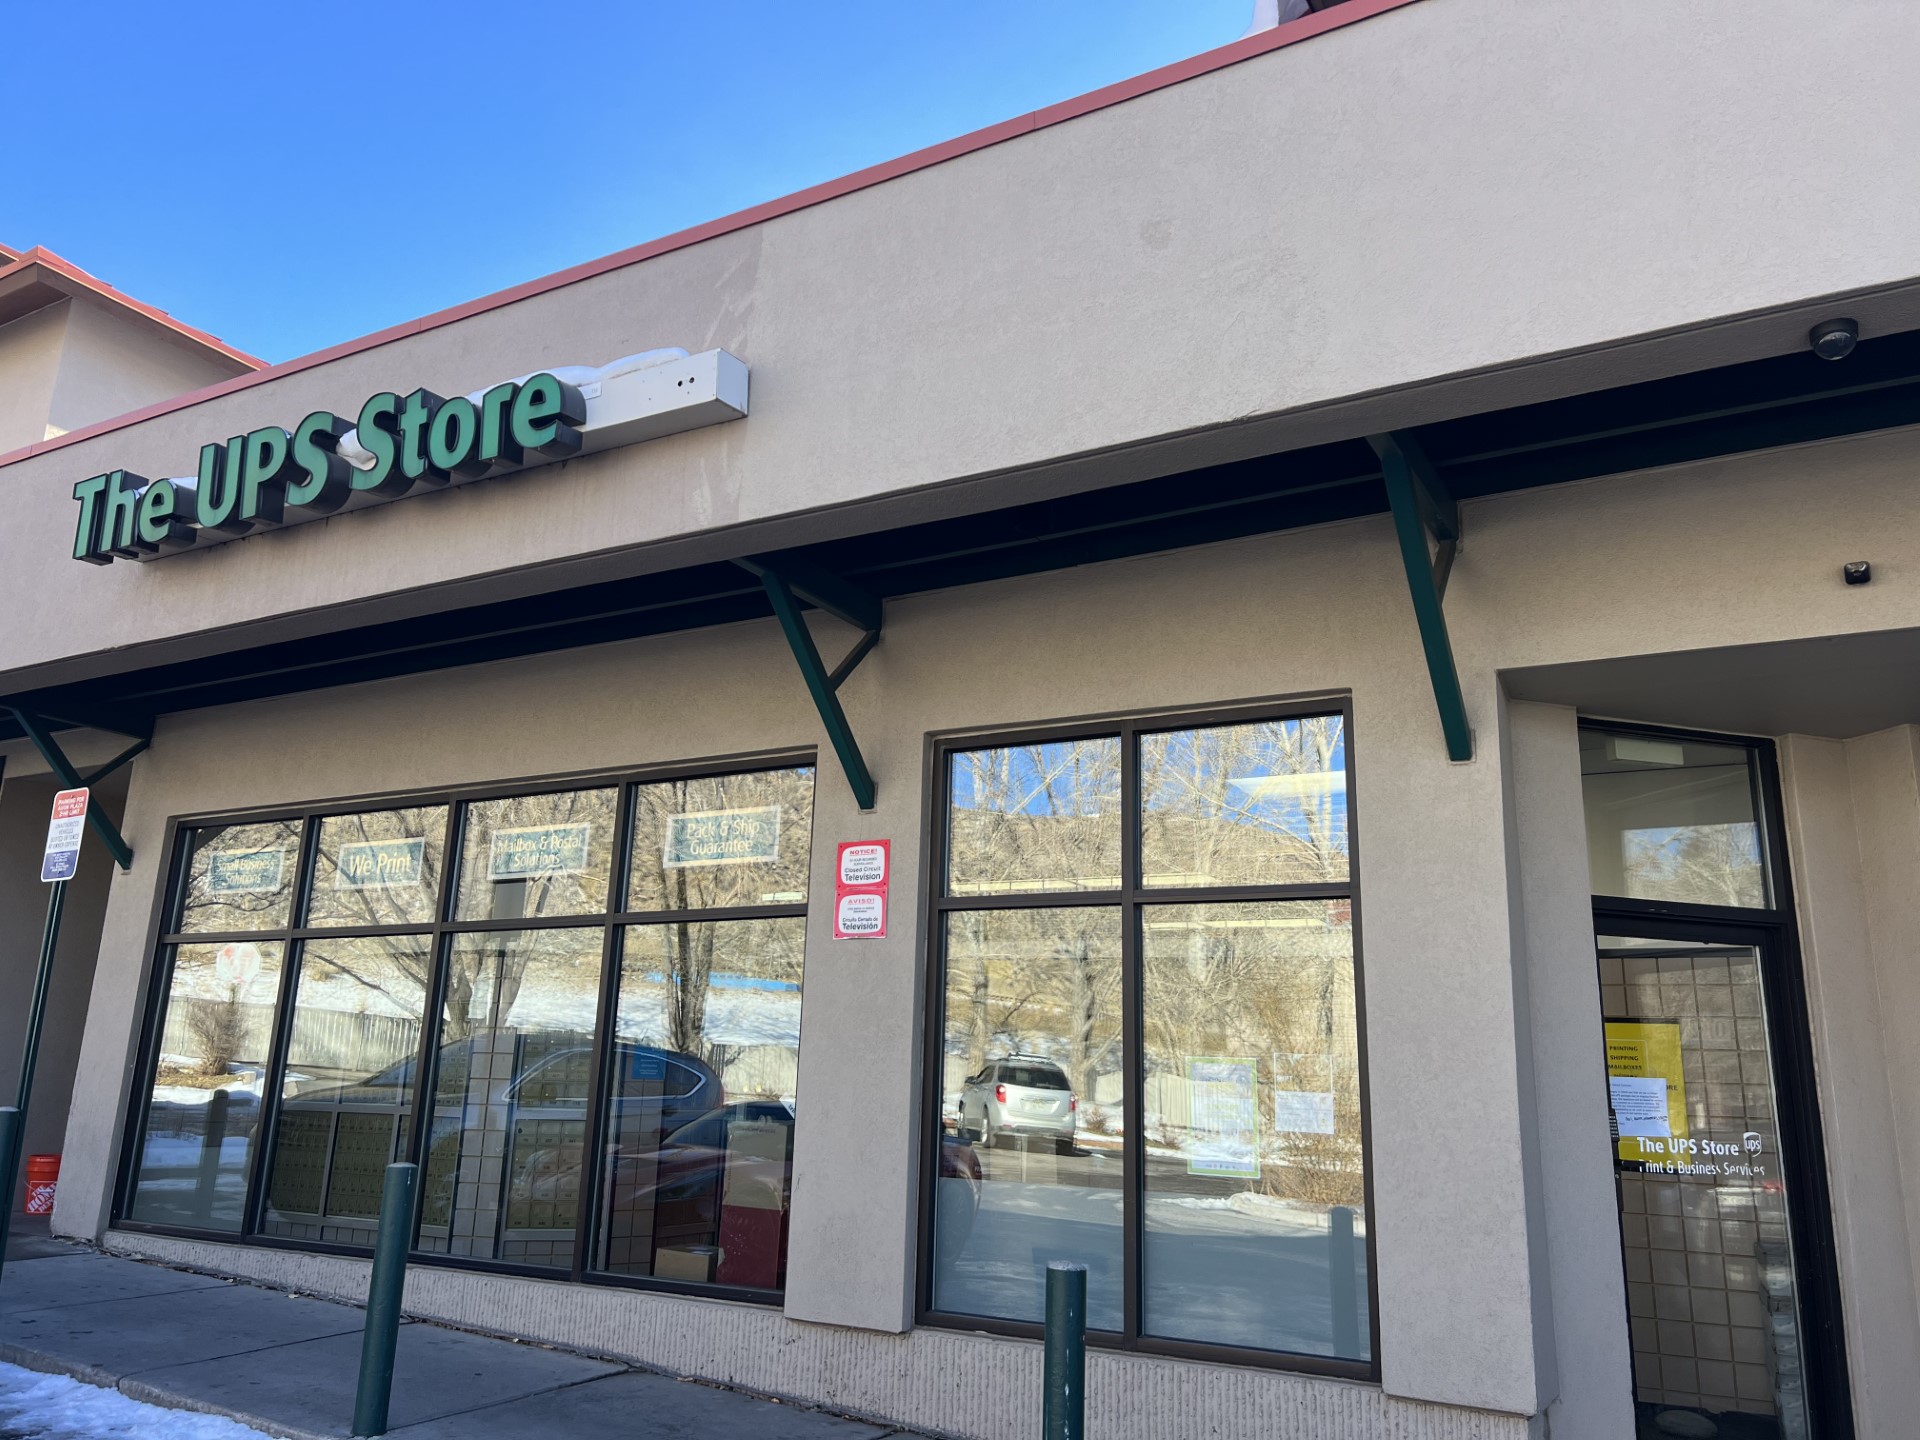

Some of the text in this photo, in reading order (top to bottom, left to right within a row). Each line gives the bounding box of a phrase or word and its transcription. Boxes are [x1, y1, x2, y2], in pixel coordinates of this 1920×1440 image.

[72, 372, 562, 561] The UPS Store
[687, 819, 760, 839] Pack & Ship
[496, 833, 582, 855] Mailbox & Postal
[690, 838, 752, 855] Guarantee
[216, 858, 239, 873] Small
[350, 853, 412, 876] We Print
[513, 850, 560, 869] Solutions
[844, 873, 881, 882] Television
[842, 922, 878, 930] Televisión
[1637, 1137, 1739, 1156] The UPS Store
[1666, 1160, 1674, 1173] &
